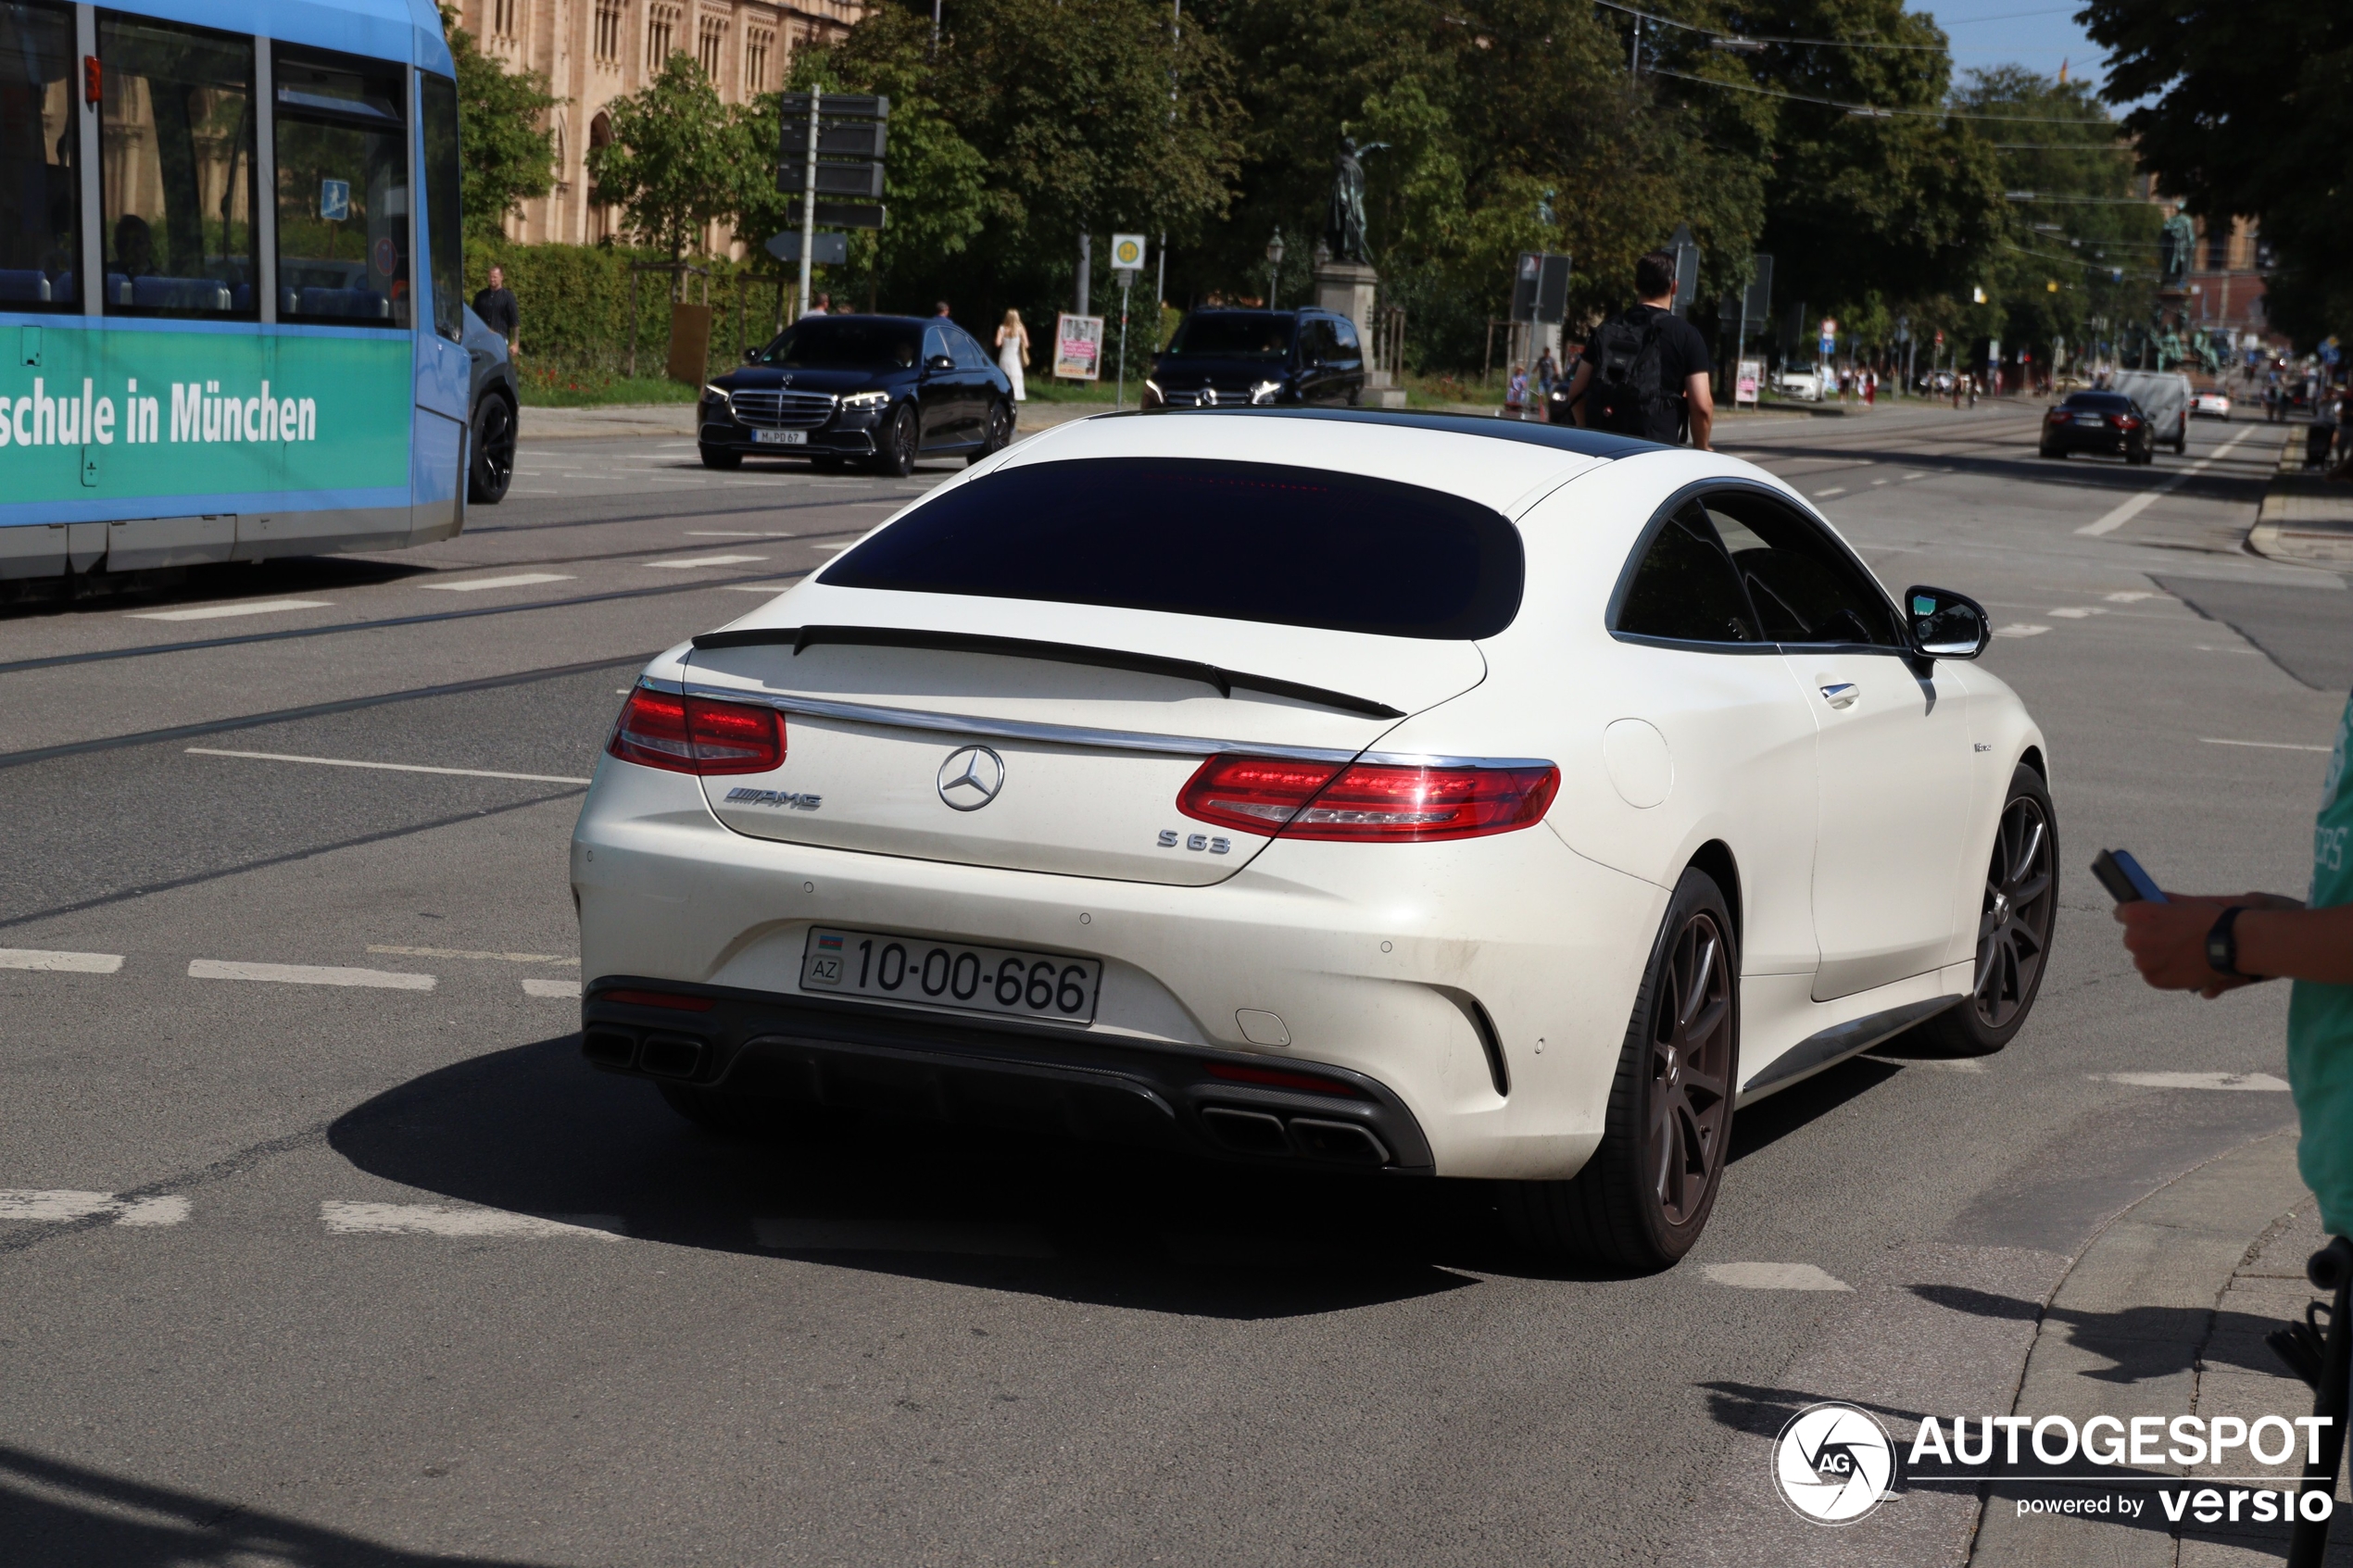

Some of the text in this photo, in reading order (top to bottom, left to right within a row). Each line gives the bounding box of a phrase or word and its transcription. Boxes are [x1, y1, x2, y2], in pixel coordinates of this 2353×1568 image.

[127, 378, 158, 443] in
[170, 380, 316, 443] München
[755, 789, 823, 808] AMG
[1158, 829, 1231, 854] S 63
[812, 960, 837, 979] AZ
[859, 939, 1088, 1014] 10-00-666
